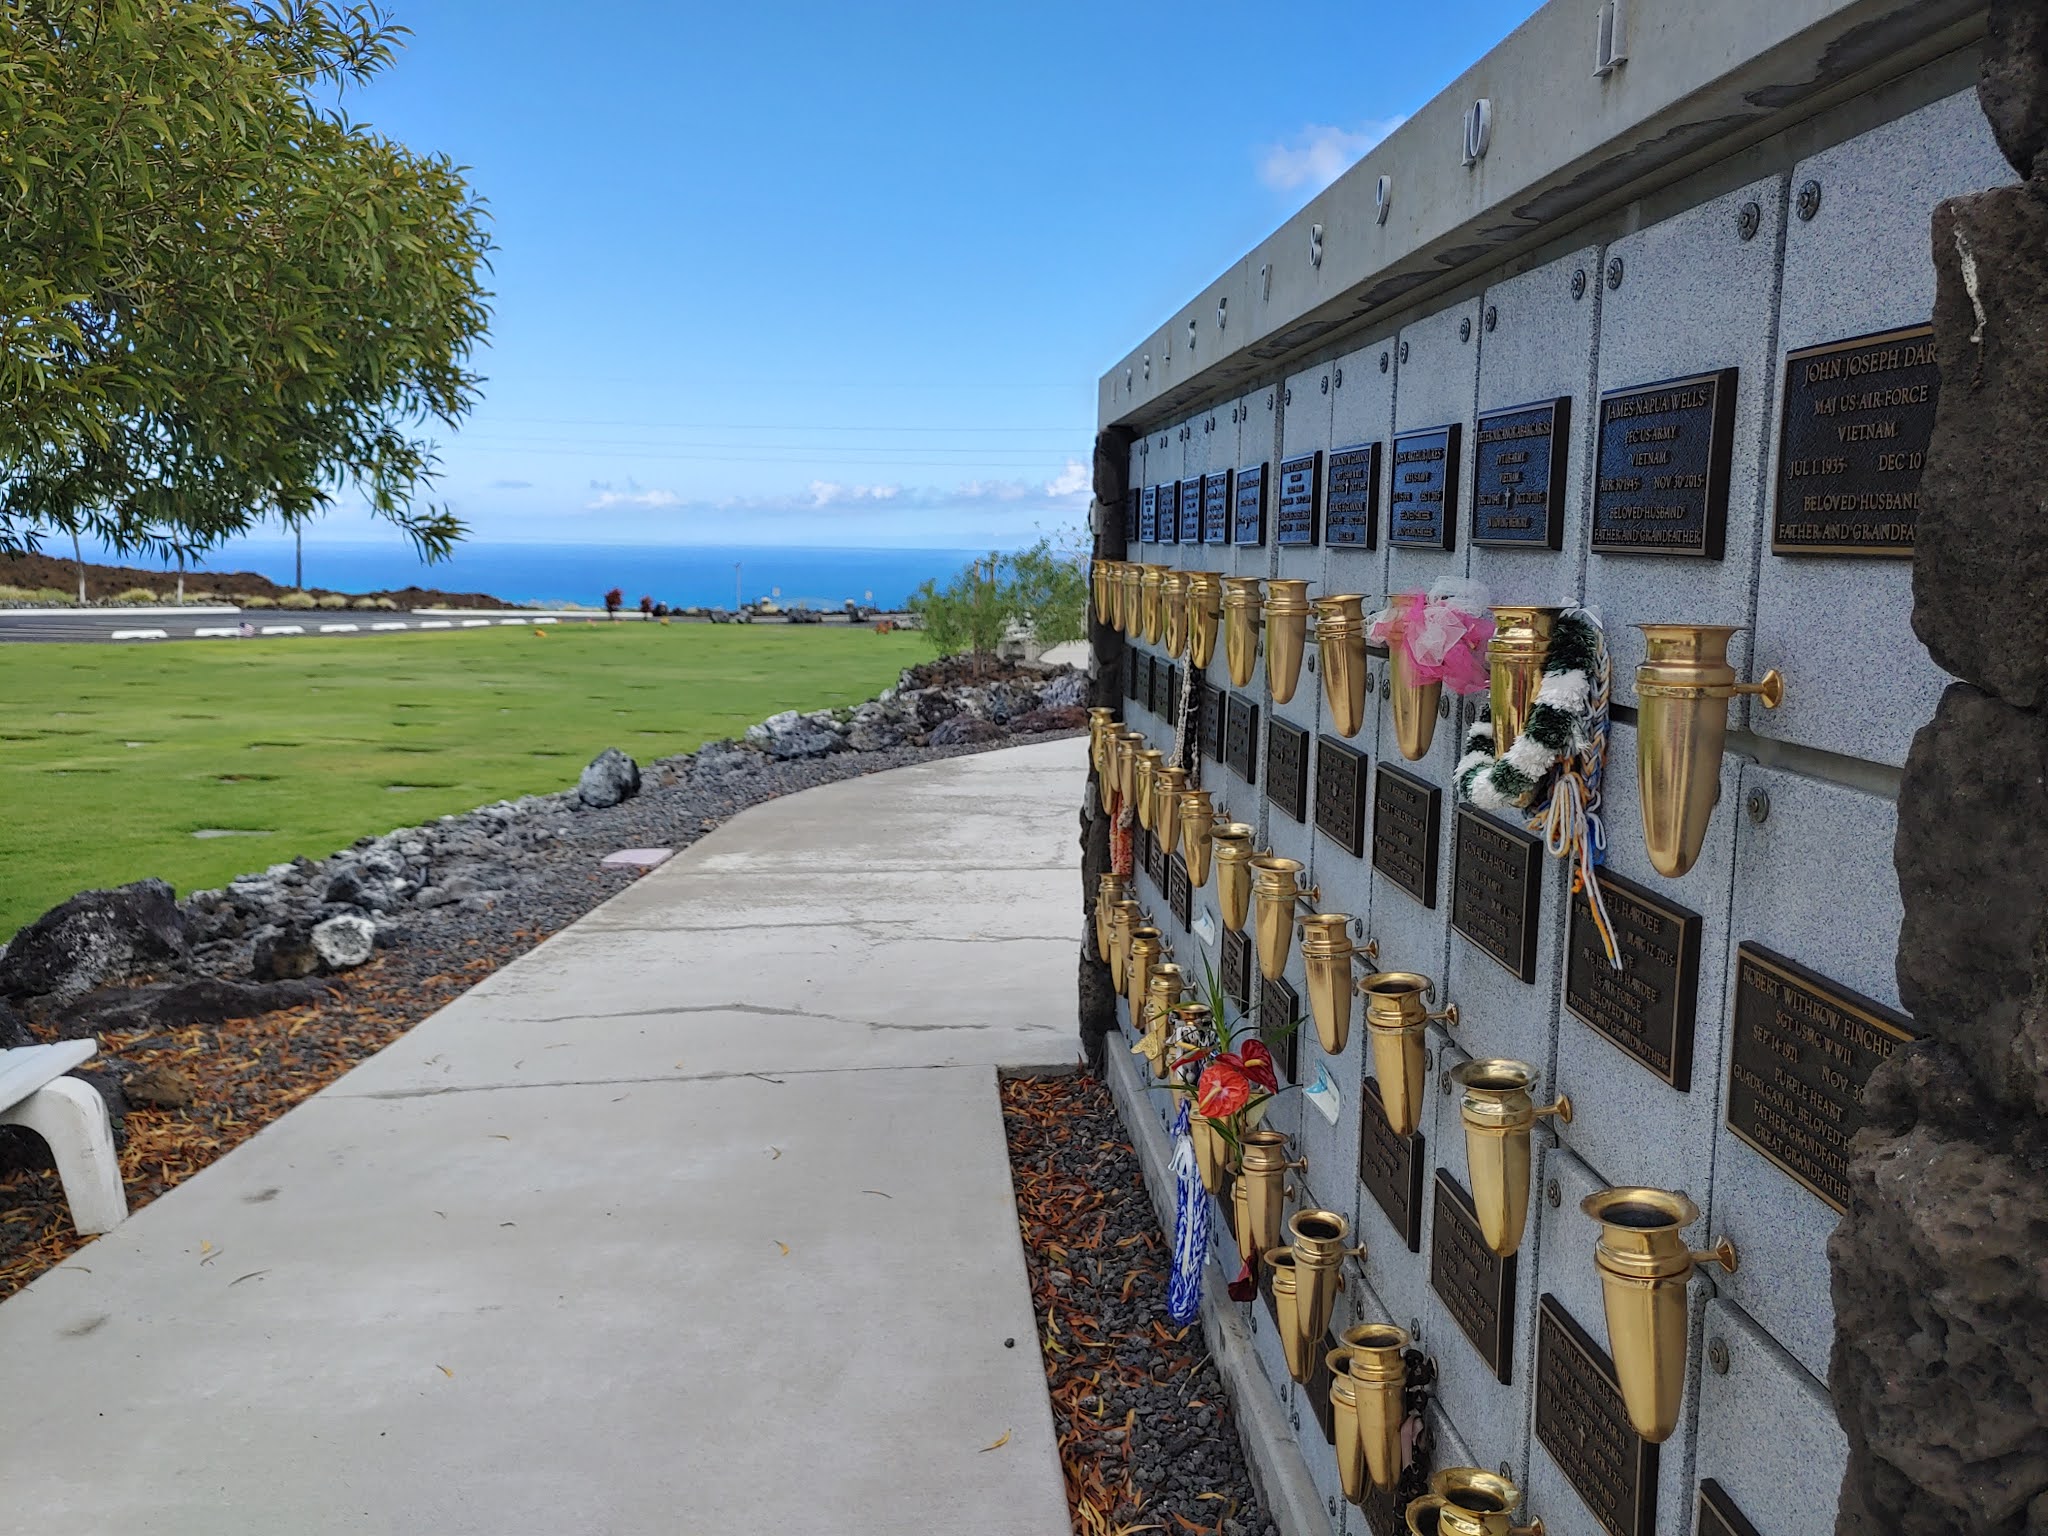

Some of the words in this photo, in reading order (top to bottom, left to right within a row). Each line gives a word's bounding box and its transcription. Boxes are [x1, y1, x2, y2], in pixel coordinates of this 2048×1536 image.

[1592, 0, 1627, 77] 11
[1461, 98, 1491, 167] 10
[1375, 174, 1391, 224] 9
[1309, 223, 1323, 267] 8
[1261, 263, 1273, 301] 7
[1217, 297, 1227, 329] 6
[1803, 359, 1841, 386] JOHN
[1844, 349, 1898, 380] JOSEPH
[1903, 342, 1938, 367] DAR
[1606, 402, 1633, 423] JAMES
[1636, 397, 1668, 415] NAPUA
[1670, 390, 1705, 410] WELLS
[1814, 398, 1836, 417] MAJ
[1840, 395, 1858, 412] US
[1859, 392, 1881, 409] AIR
[1884, 385, 1929, 406] FORCE
[1640, 429, 1652, 441] US
[1652, 426, 1676, 440] ARMY
[1837, 422, 1896, 442] VIETNAM
[1630, 452, 1667, 466] VIETNAM
[1789, 461, 1809, 479] JUL
[1821, 458, 1844, 474] 1935
[1878, 453, 1905, 471] DEC
[1909, 452, 1922, 469] 10
[1654, 477, 1673, 488] NOV
[1684, 475, 1702, 487] 2015
[1609, 508, 1643, 518] BELOVED
[1644, 507, 1683, 518] HUSBAND
[1803, 495, 1856, 511] BELOVED
[1595, 529, 1621, 540] FATHER
[1621, 530, 1638, 541] AND
[1640, 530, 1702, 543] GRANDFATHER
[1779, 524, 1819, 539] FATHER
[1822, 524, 1849, 538] AND
[1852, 524, 1916, 540] GRANDFA
[1622, 902, 1660, 934] HARDEE
[1590, 988, 1622, 1019] BELOVED
[1617, 988, 1641, 1013] FORCE
[1625, 973, 1657, 1003] HARDEE
[1743, 965, 1779, 998] ROBERT
[1782, 986, 1840, 1032] WITHROW
[1776, 1011, 1792, 1031] SGT
[1795, 1022, 1822, 1048] USMC
[1823, 1037, 1852, 1065] WWII
[1753, 1024, 1768, 1045] SEP
[1822, 1066, 1849, 1094] NOV
[1733, 1062, 1796, 1116] GUADALCANAL
[1798, 1107, 1840, 1146] BELOVED
[1775, 1067, 1808, 1100] PURPLE
[1810, 1089, 1843, 1123] HEART
[1754, 1099, 1786, 1132] FATHER
[1788, 1124, 1849, 1177] GRANDFATH
[1755, 1123, 1783, 1154] GREAT
[1784, 1144, 1851, 1203] GRANDFATHE
